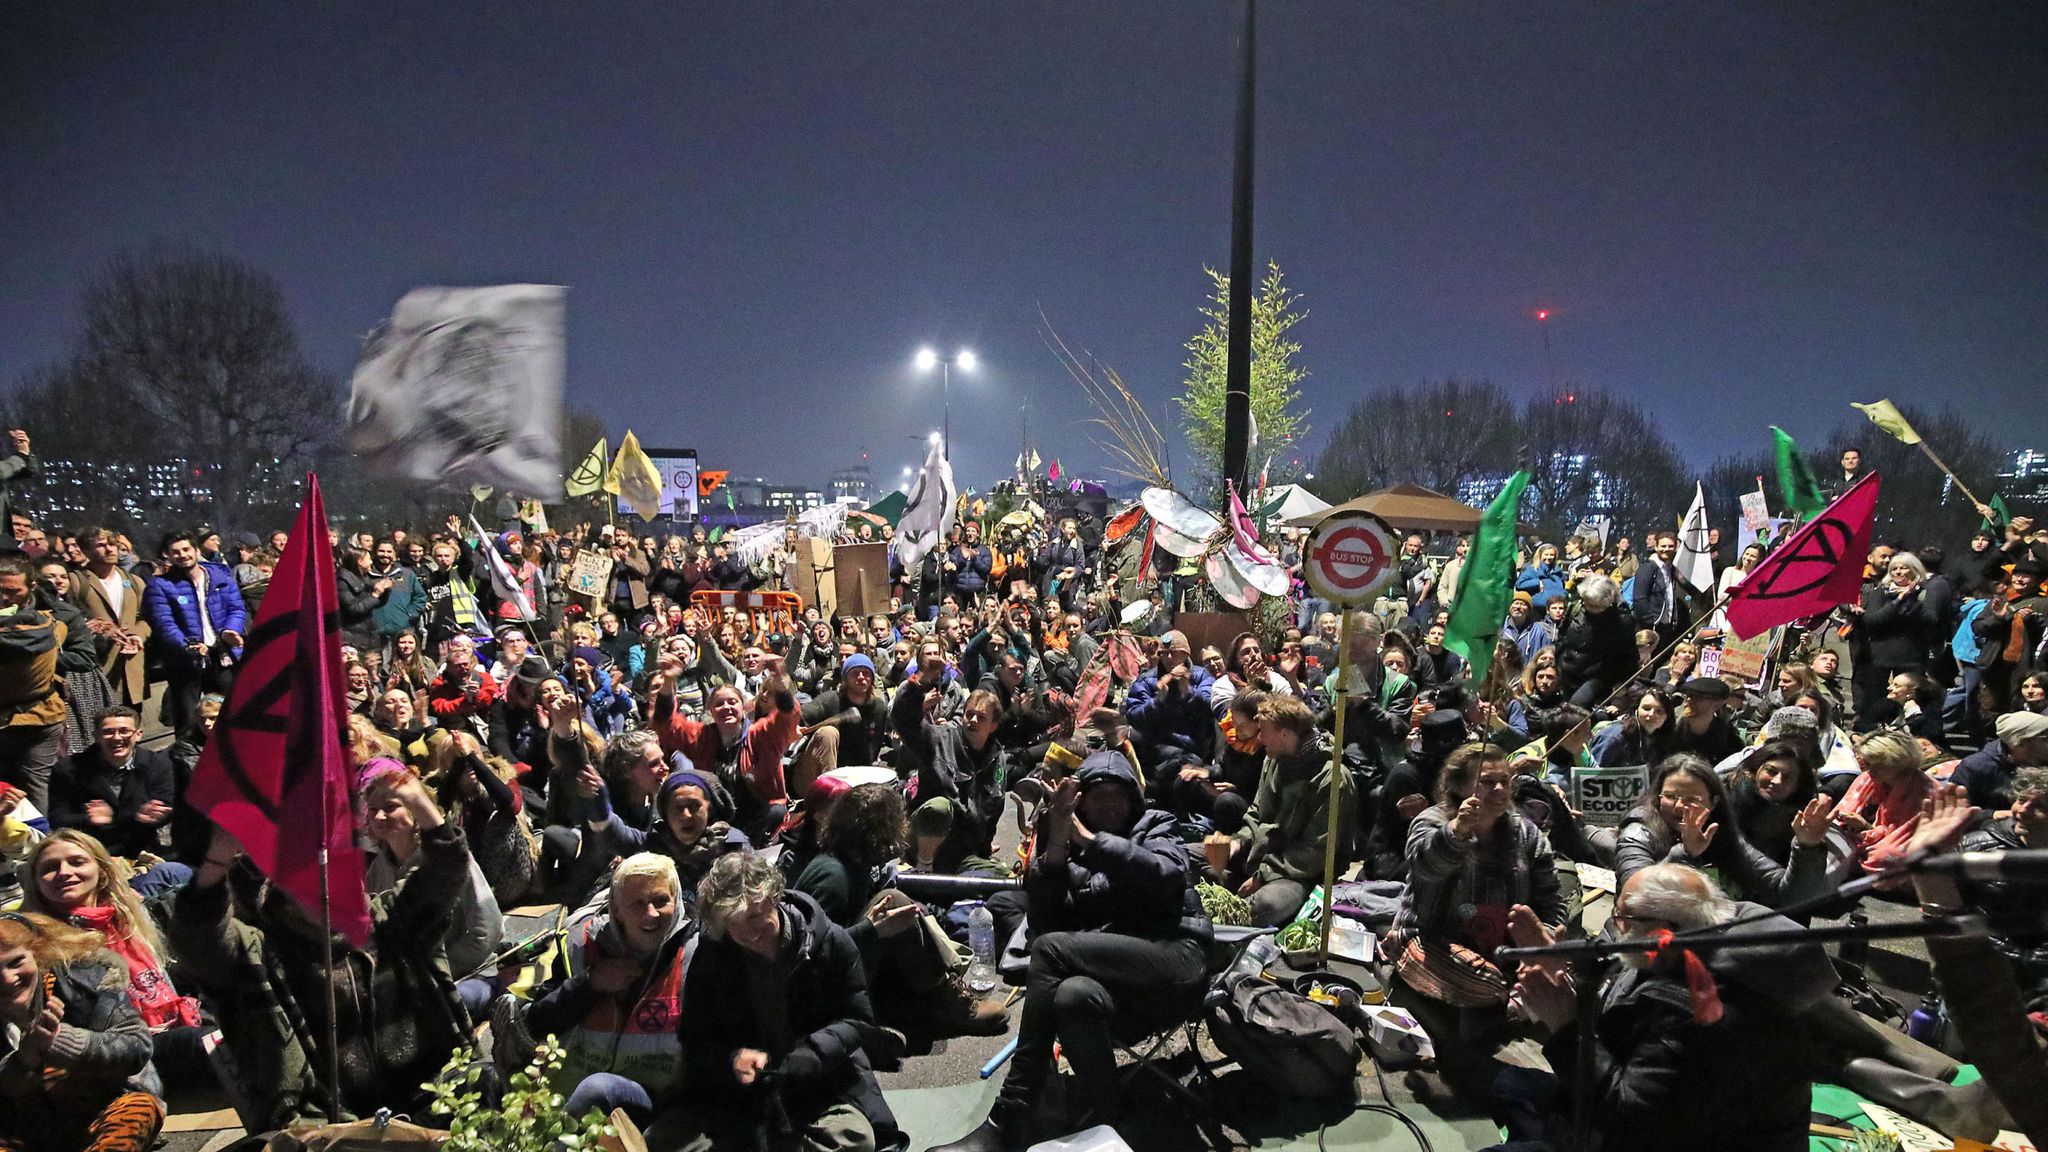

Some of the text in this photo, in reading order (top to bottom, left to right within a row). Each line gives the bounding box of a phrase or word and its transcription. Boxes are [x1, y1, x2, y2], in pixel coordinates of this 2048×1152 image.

[1330, 552, 1374, 564] BUS STOP
[1582, 776, 1643, 800] STOP
[1582, 800, 1636, 811] ECOCI
